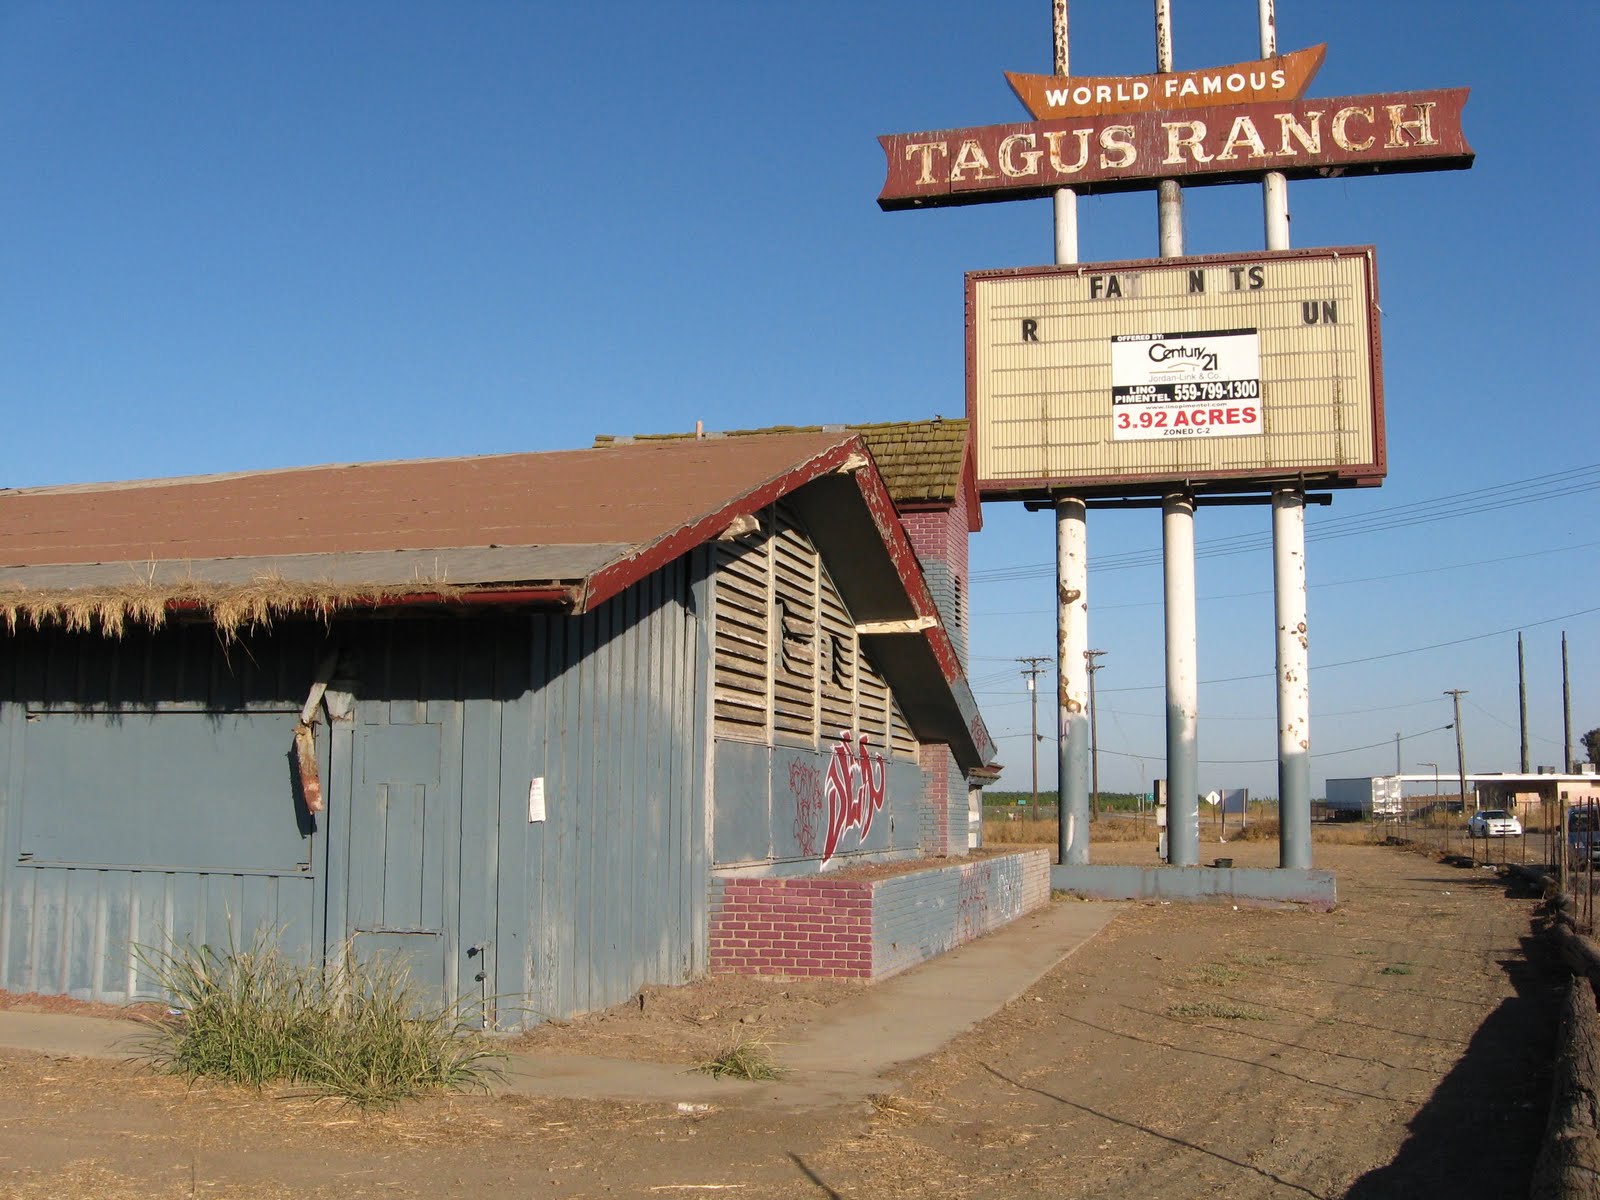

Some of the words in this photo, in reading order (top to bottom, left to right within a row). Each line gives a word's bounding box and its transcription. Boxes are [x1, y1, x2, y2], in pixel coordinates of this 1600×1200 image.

[1045, 82, 1149, 107] WORLD
[1165, 69, 1286, 98] FAMOUS
[905, 127, 1137, 185] TAGUS
[1161, 102, 1439, 165] RANCH
[1303, 301, 1337, 324] UN
[1117, 334, 1150, 342] OFFERED
[1149, 343, 1206, 362] Century
[1201, 353, 1218, 371] 21
[1148, 373, 1196, 383] Jordan-Link
[1199, 372, 1205, 380] &
[1115, 393, 1171, 404] PIMENTEL
[1129, 385, 1156, 395] LINO
[1174, 380, 1257, 401] 559-799-1300
[1118, 411, 1168, 429] 3.92
[1174, 407, 1257, 427] ACRES
[1163, 428, 1194, 436] ZONED
[1197, 427, 1210, 435] C-2
